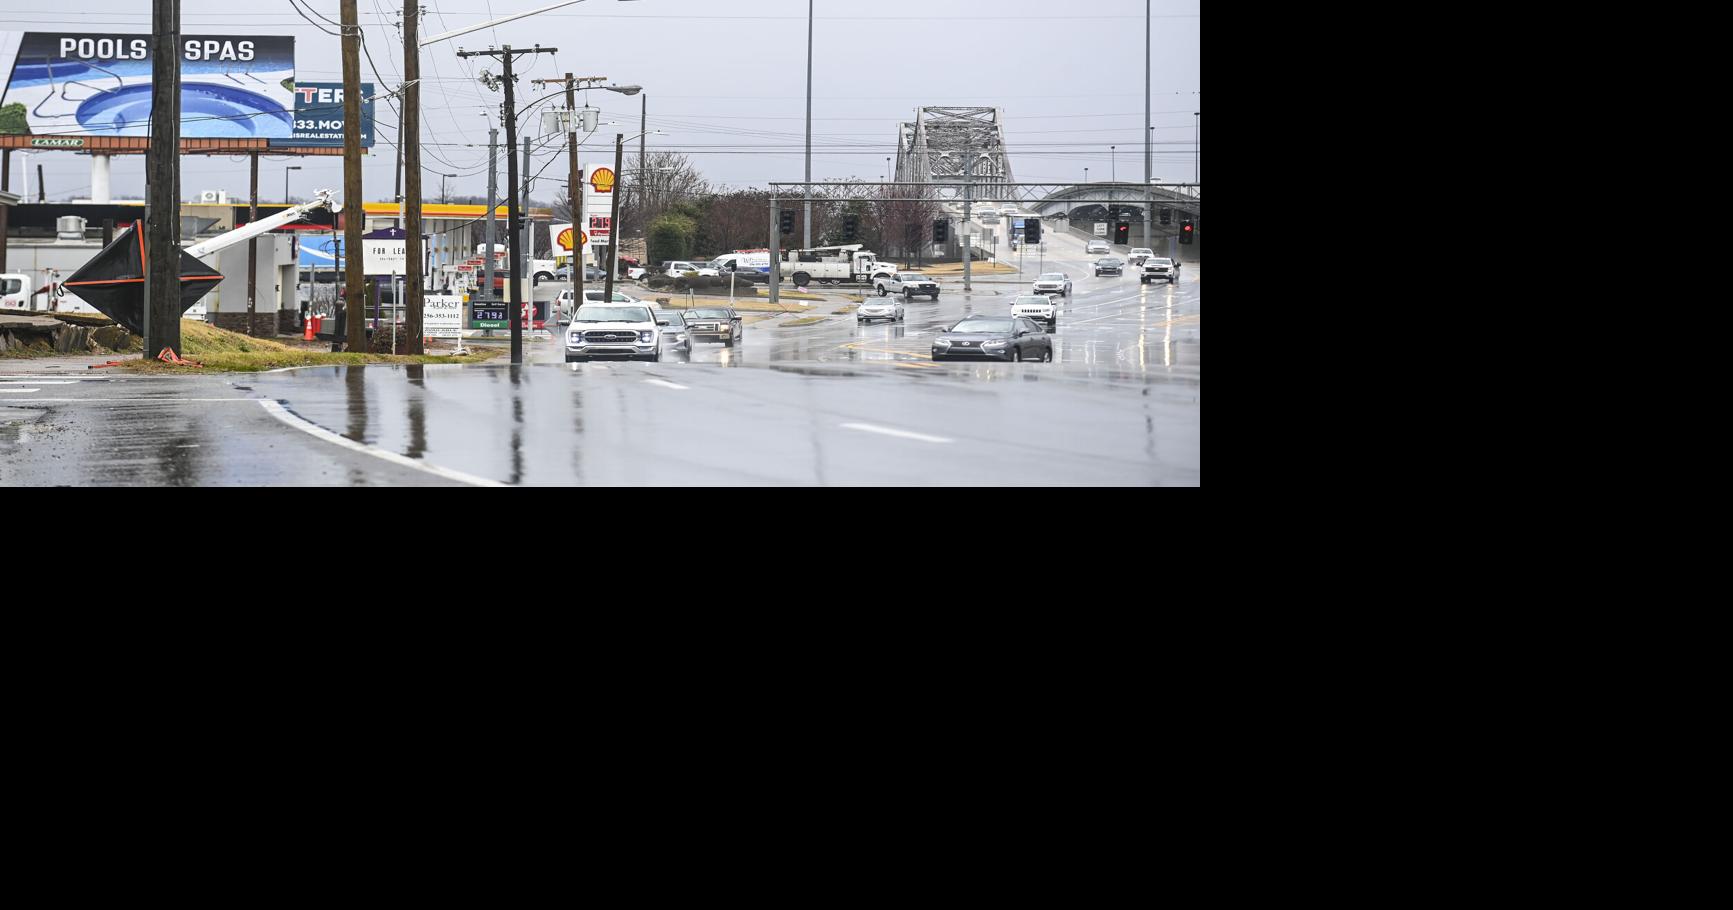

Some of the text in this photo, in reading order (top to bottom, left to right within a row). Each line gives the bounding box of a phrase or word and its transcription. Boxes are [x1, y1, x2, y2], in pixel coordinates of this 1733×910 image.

[60, 38, 255, 61] POOLS SPAS
[295, 87, 364, 104] TER
[33, 139, 80, 147] LAMAR
[372, 247, 406, 255] FOR LEA
[423, 298, 460, 309] Parker
